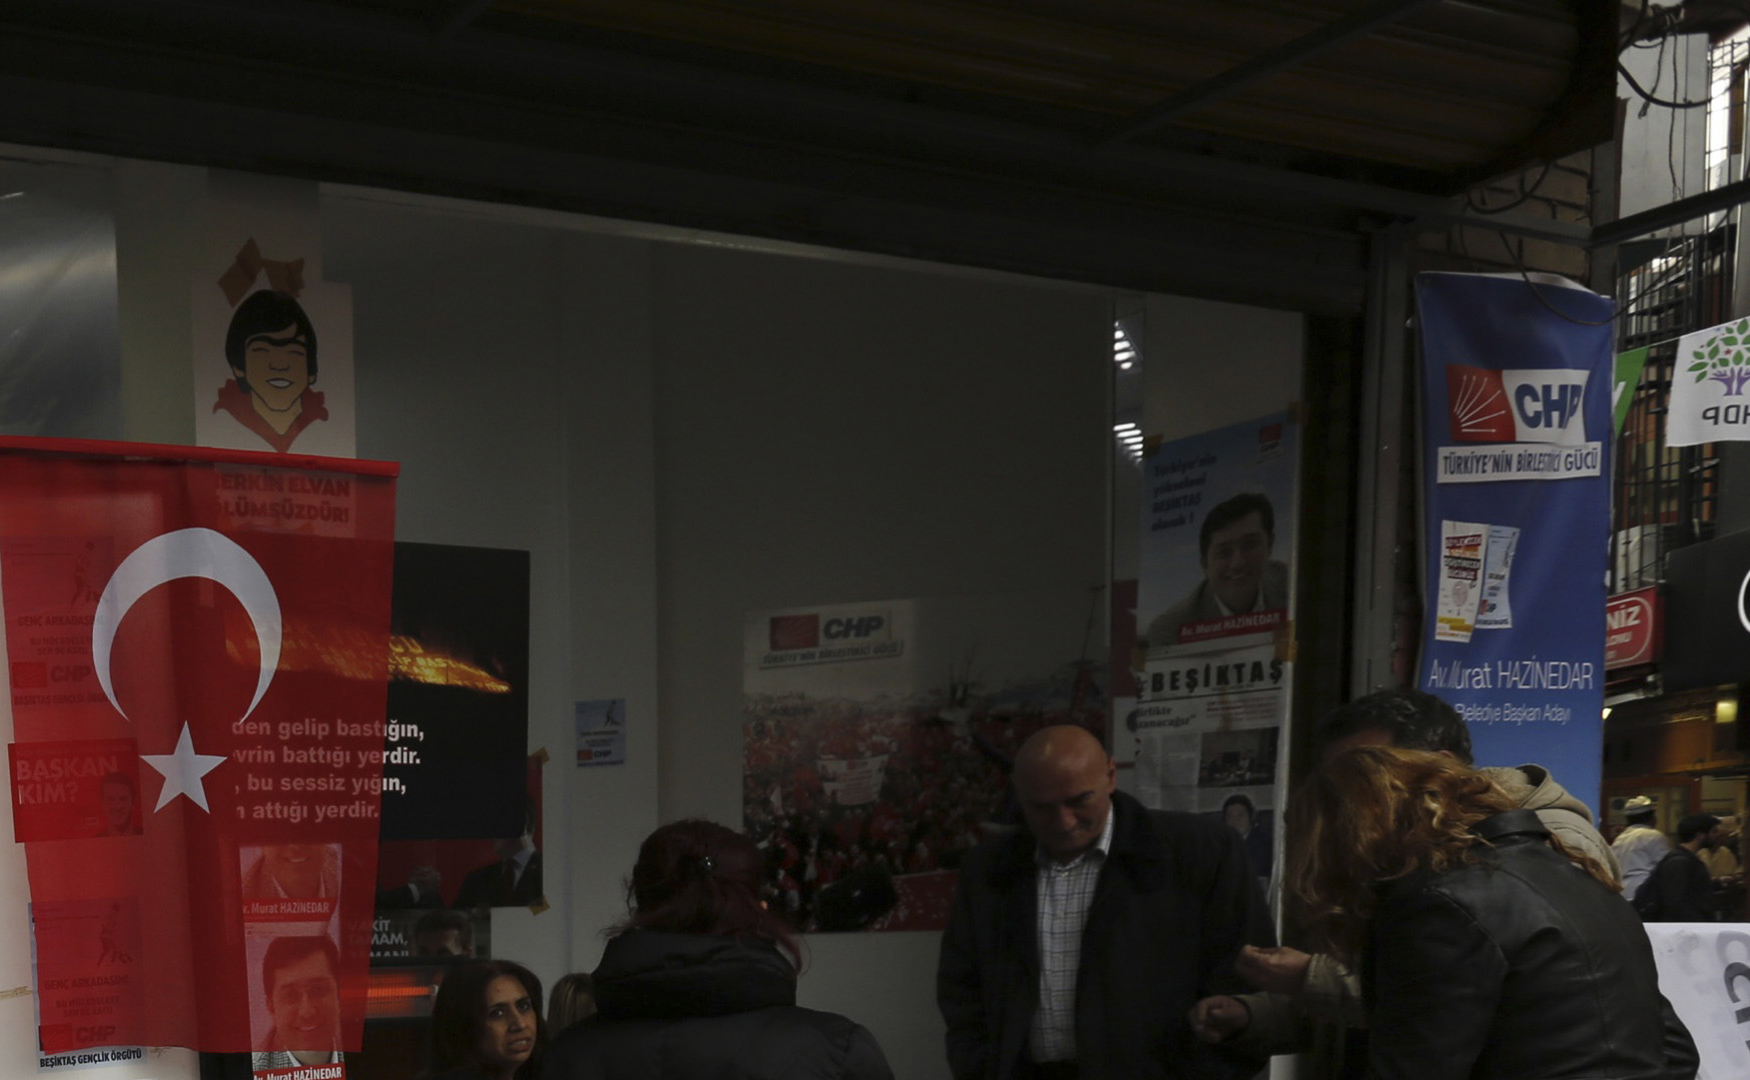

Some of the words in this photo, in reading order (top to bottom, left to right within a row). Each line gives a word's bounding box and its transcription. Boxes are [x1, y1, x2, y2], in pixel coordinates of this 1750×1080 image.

[1515, 384, 1582, 429] CHP
[1443, 451, 1512, 474] TÜRKİYE'NİN
[1565, 448, 1598, 470] GÜCÜ
[291, 479, 351, 498] ELVAN
[823, 616, 885, 639] CHP
[1151, 660, 1284, 693] BEŞİKTAŞ
[1497, 655, 1594, 690] HAZİNEDAR
[1503, 703, 1541, 725] Başkan
[1542, 703, 1571, 725] Adayı
[278, 718, 330, 740] gelip
[337, 718, 424, 740] bastığın,
[283, 745, 351, 768] battığı
[357, 746, 421, 769] yerdir.
[248, 774, 273, 791] bu
[280, 774, 346, 791] sessiz
[352, 775, 406, 795] yığın,
[252, 801, 308, 822] attığı
[314, 801, 379, 823] yerdir.
[293, 1066, 343, 1080] HAZİNEDAR
